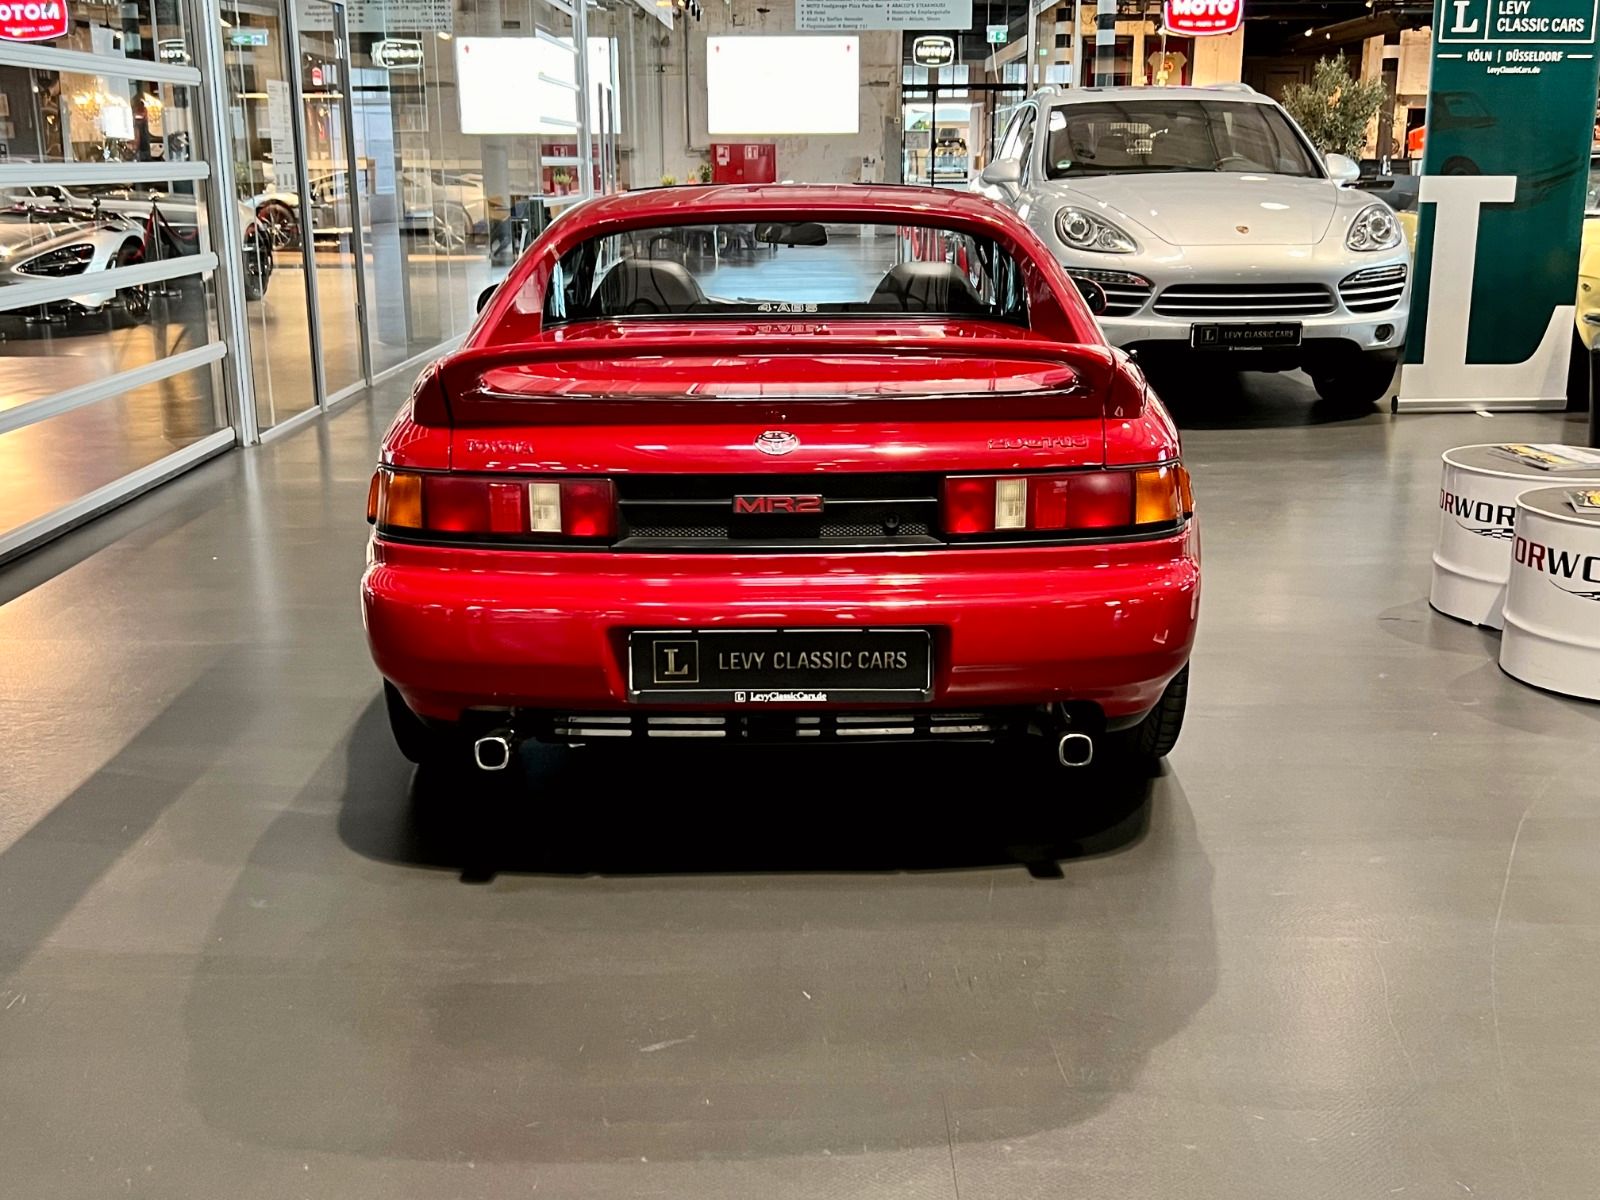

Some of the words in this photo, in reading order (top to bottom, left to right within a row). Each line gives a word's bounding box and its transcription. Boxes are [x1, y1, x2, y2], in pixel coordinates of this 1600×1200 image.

[1172, 0, 1235, 16] MOTO
[1498, 0, 1530, 15] LEVY
[1450, 0, 1478, 33] L
[1497, 18, 1549, 33] CLASSIC
[1551, 18, 1585, 33] CARS
[1467, 48, 1493, 62] KÖLN
[1505, 48, 1564, 62] DÜSSELDORF
[1224, 331, 1241, 339] LEVY
[1244, 330, 1274, 338] CLASSIC
[1275, 330, 1294, 338] CARS
[735, 496, 822, 513] MR2
[663, 648, 688, 675] L
[719, 651, 766, 670] LEVY
[773, 651, 852, 669] CLASSIC
[858, 651, 908, 669] CARS
[750, 692, 828, 703] LevyClassicCars.de
